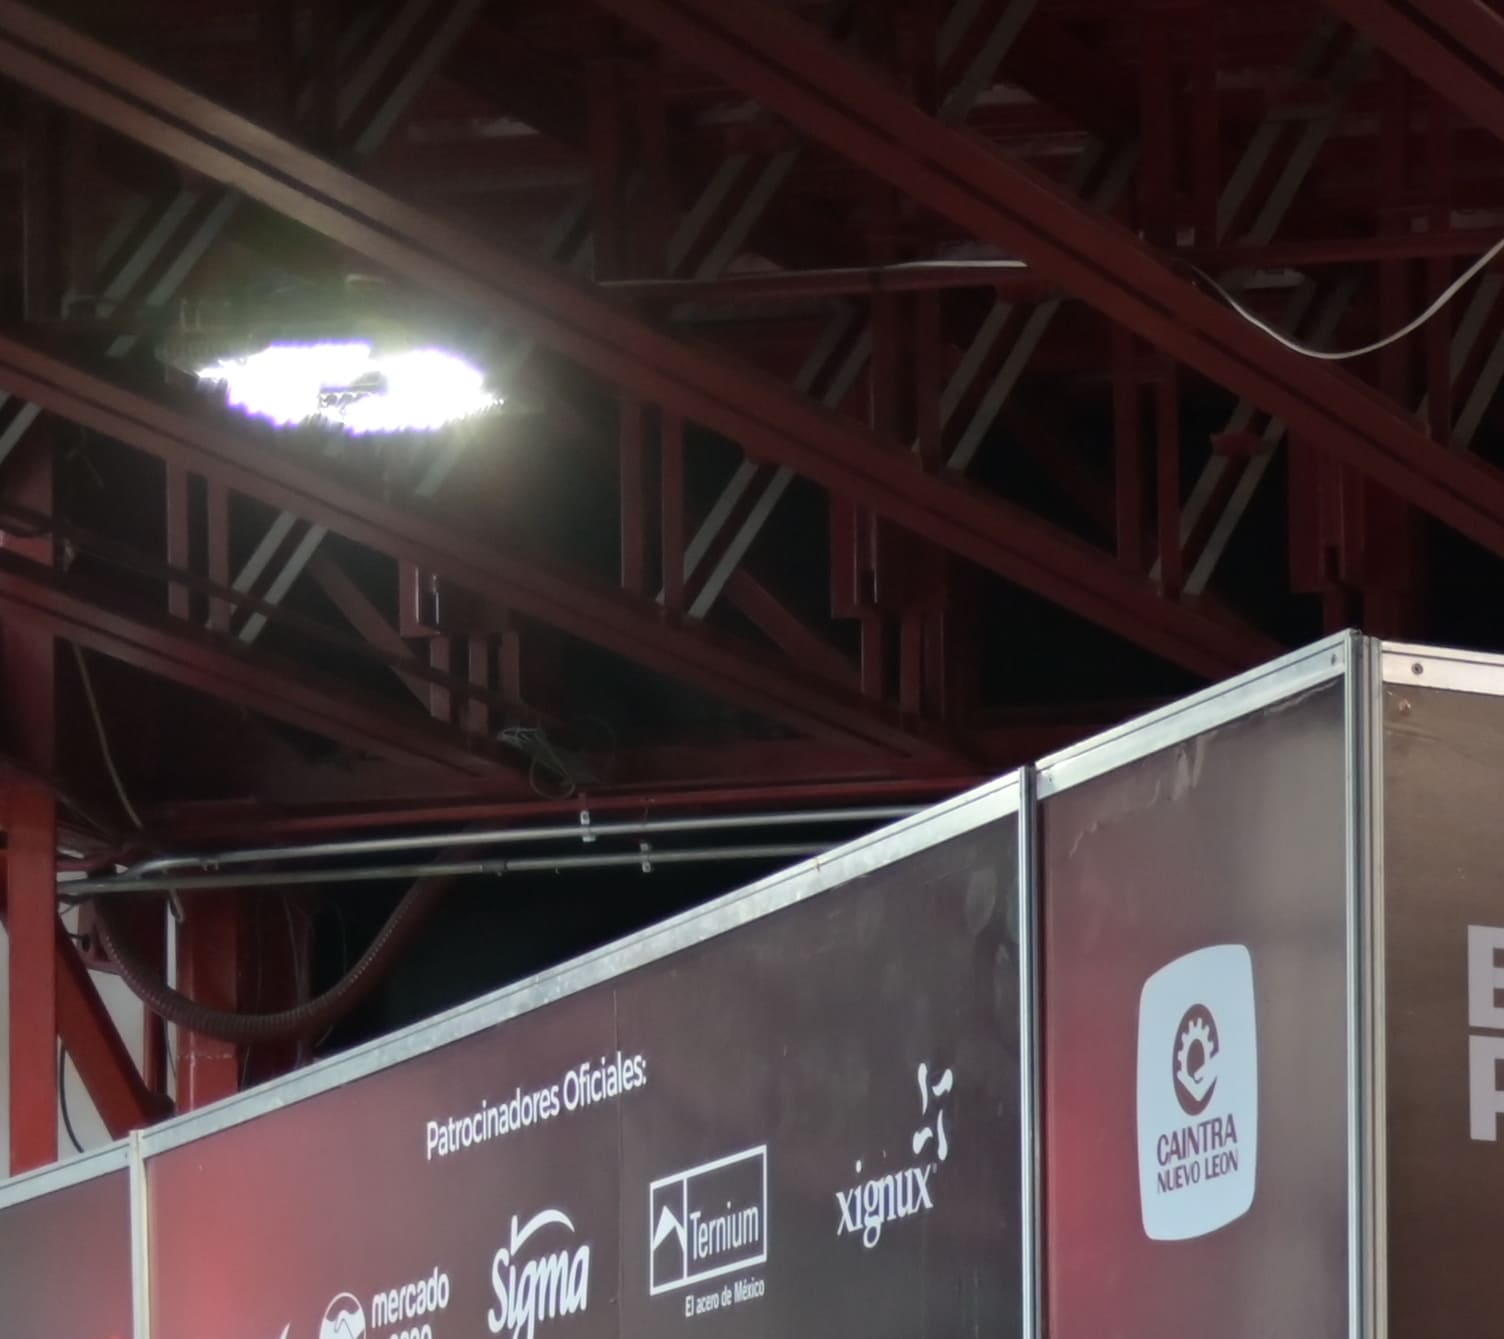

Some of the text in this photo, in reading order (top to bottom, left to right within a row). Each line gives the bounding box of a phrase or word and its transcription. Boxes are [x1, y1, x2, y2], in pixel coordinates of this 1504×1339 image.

[426, 1051, 647, 1161] Patrocinadores Oficiales:
[1156, 1115, 1238, 1166] CAINTRA
[1156, 1144, 1238, 1195] NUEVO LEON
[689, 1201, 760, 1260] Ternium
[835, 1159, 934, 1249] xignux
[371, 1266, 450, 1333] mercado
[685, 1277, 765, 1318] El acero de México
